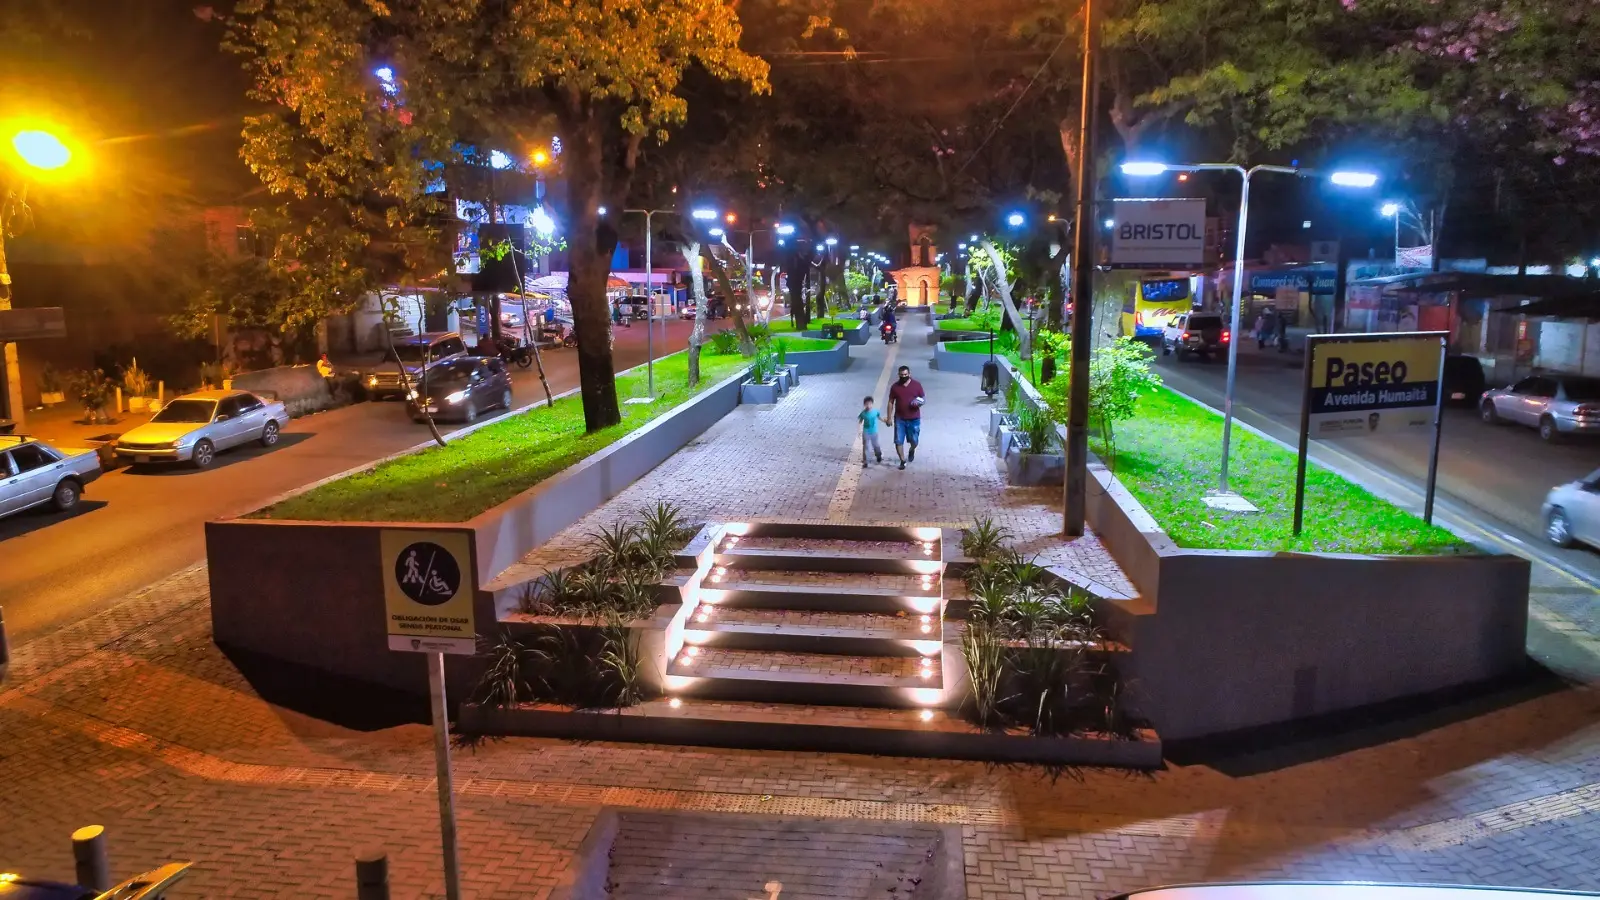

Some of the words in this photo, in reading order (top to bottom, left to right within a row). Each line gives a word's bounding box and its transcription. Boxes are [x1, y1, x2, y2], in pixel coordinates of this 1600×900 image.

[1120, 223, 1202, 240] BRISTOL
[1325, 357, 1407, 388] Paseo
[1324, 390, 1376, 406] Avenida
[1379, 386, 1427, 402] Humaitá
[391, 614, 437, 622] OBLIGACIÓN
